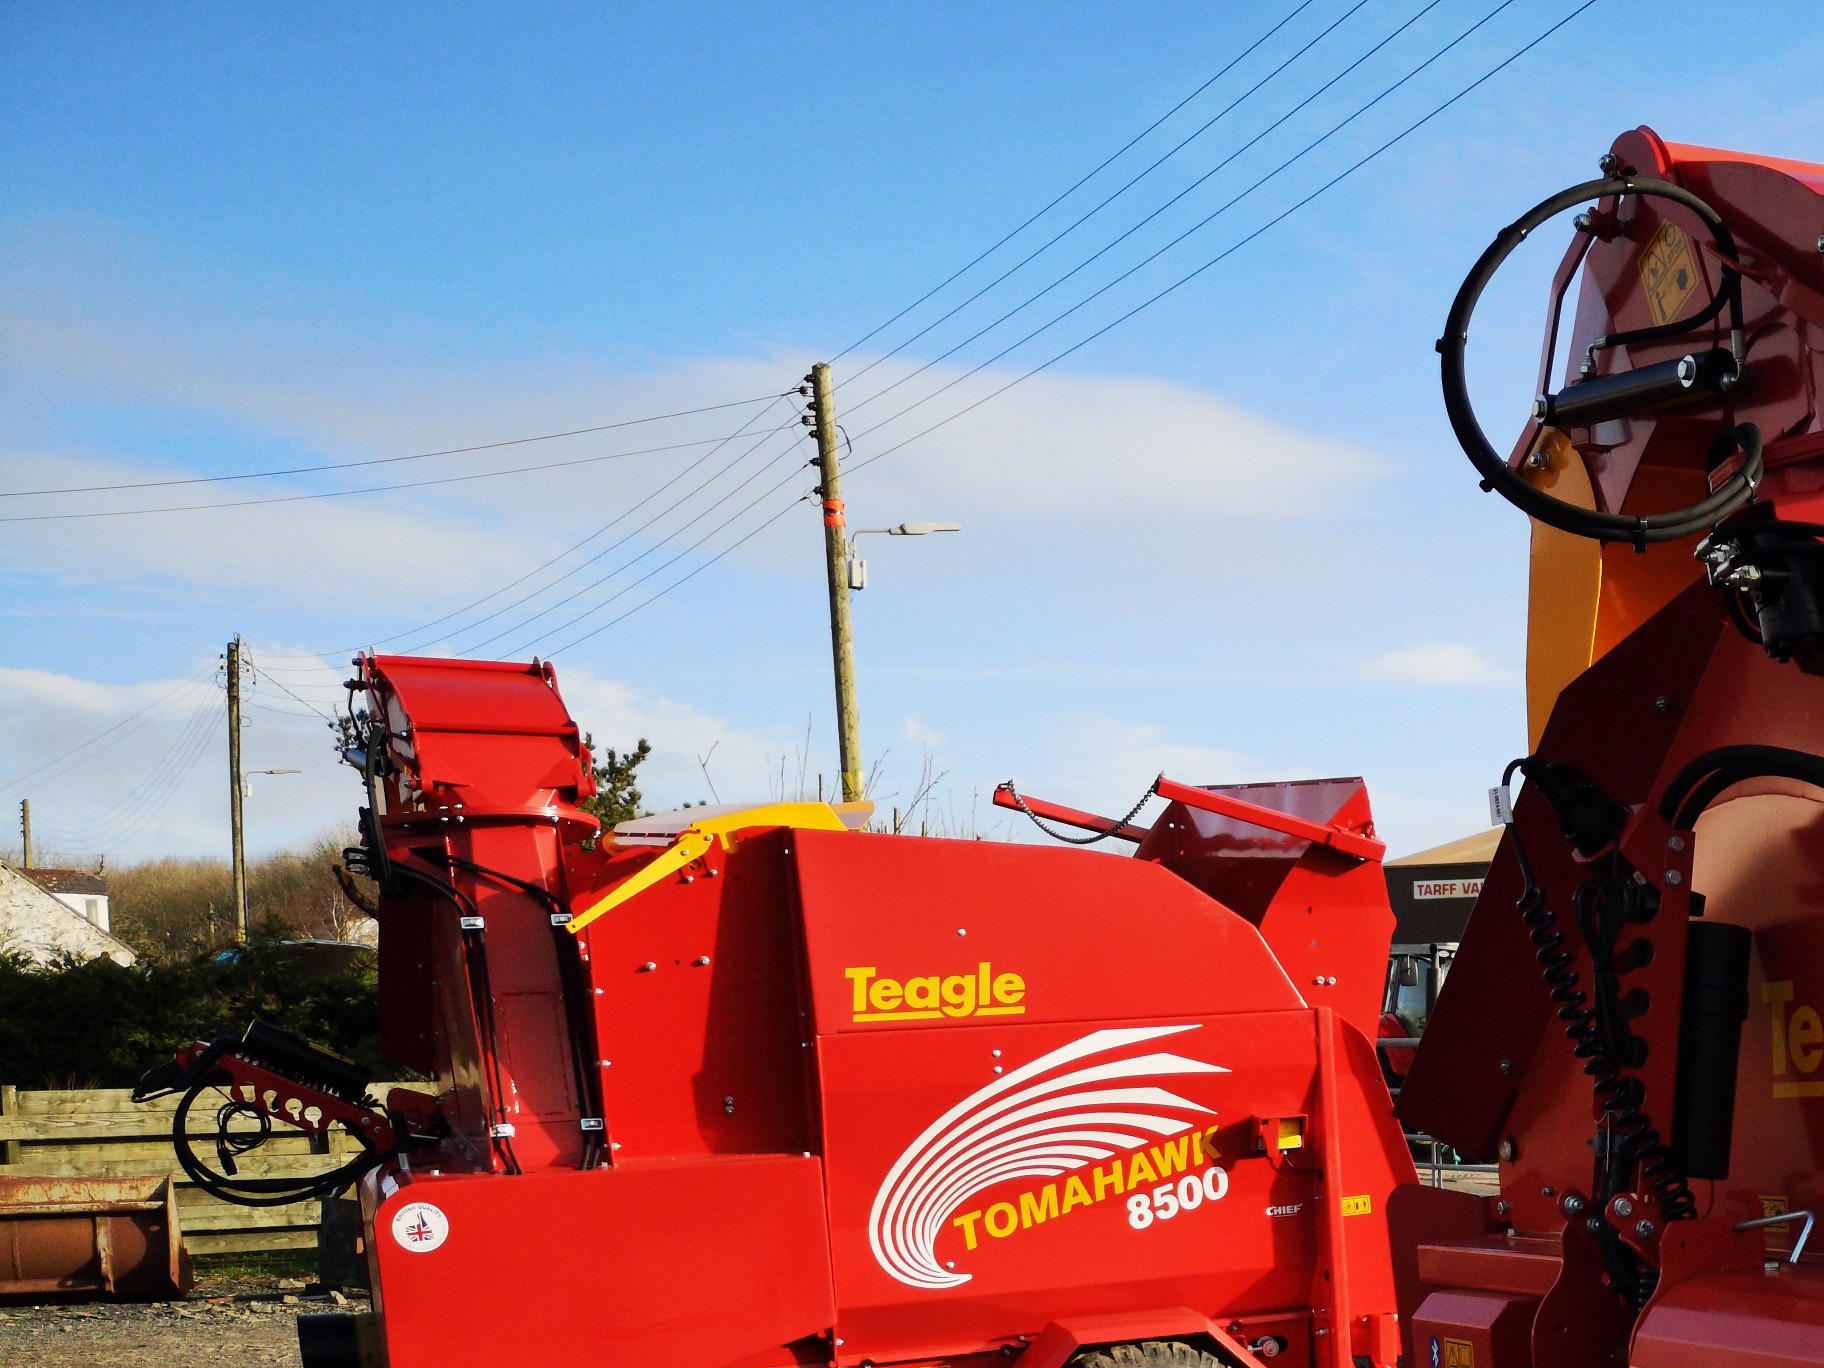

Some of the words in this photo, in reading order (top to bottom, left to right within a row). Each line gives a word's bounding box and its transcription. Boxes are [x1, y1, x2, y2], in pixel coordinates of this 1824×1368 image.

[1417, 883, 1456, 896] TARFF
[845, 962, 1026, 1018] Teagle
[953, 1125, 1219, 1250] TOMAHAWK
[1126, 1166, 1229, 1230] 8500
[417, 1204, 442, 1218] QUALITY
[1265, 1203, 1303, 1217] CHIEF
